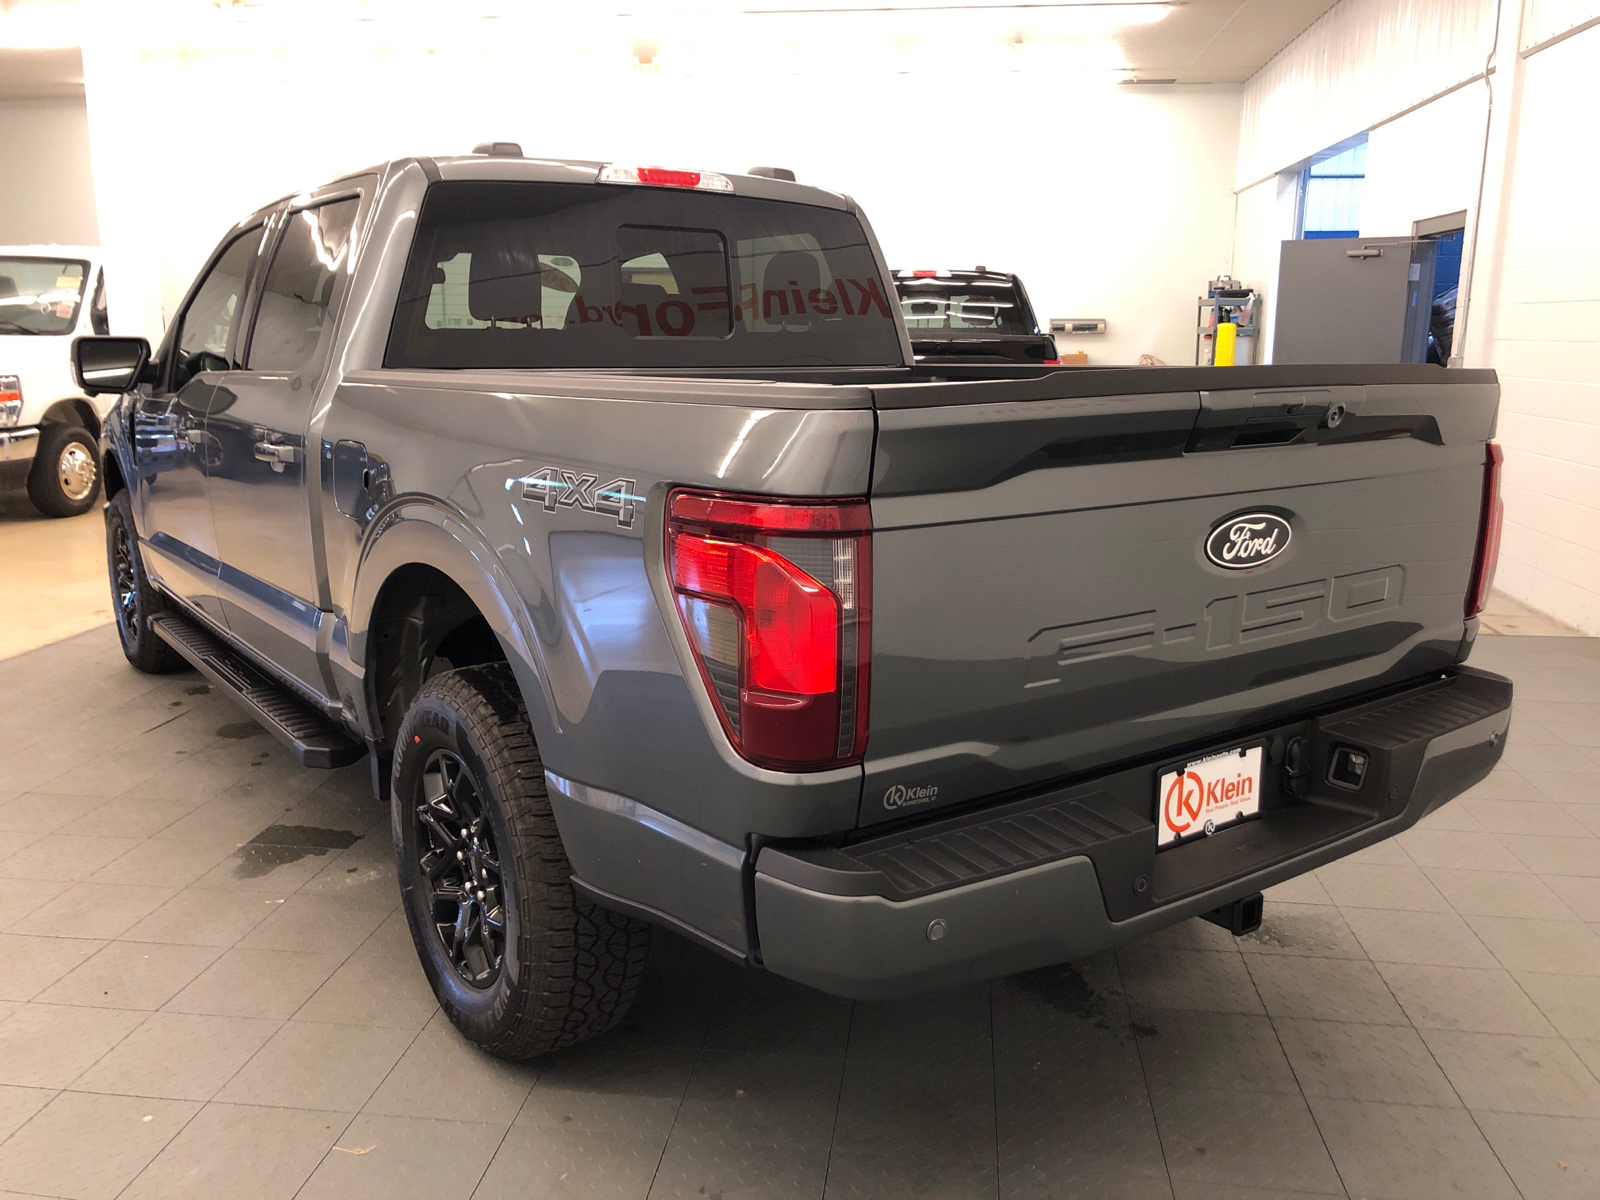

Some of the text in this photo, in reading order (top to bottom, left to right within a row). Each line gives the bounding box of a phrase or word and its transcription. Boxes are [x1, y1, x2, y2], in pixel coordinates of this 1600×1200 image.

[1222, 522, 1279, 560] Ford
[1024, 564, 1406, 688] F-150
[906, 785, 938, 800] Klein
[1206, 772, 1253, 807] Klein
